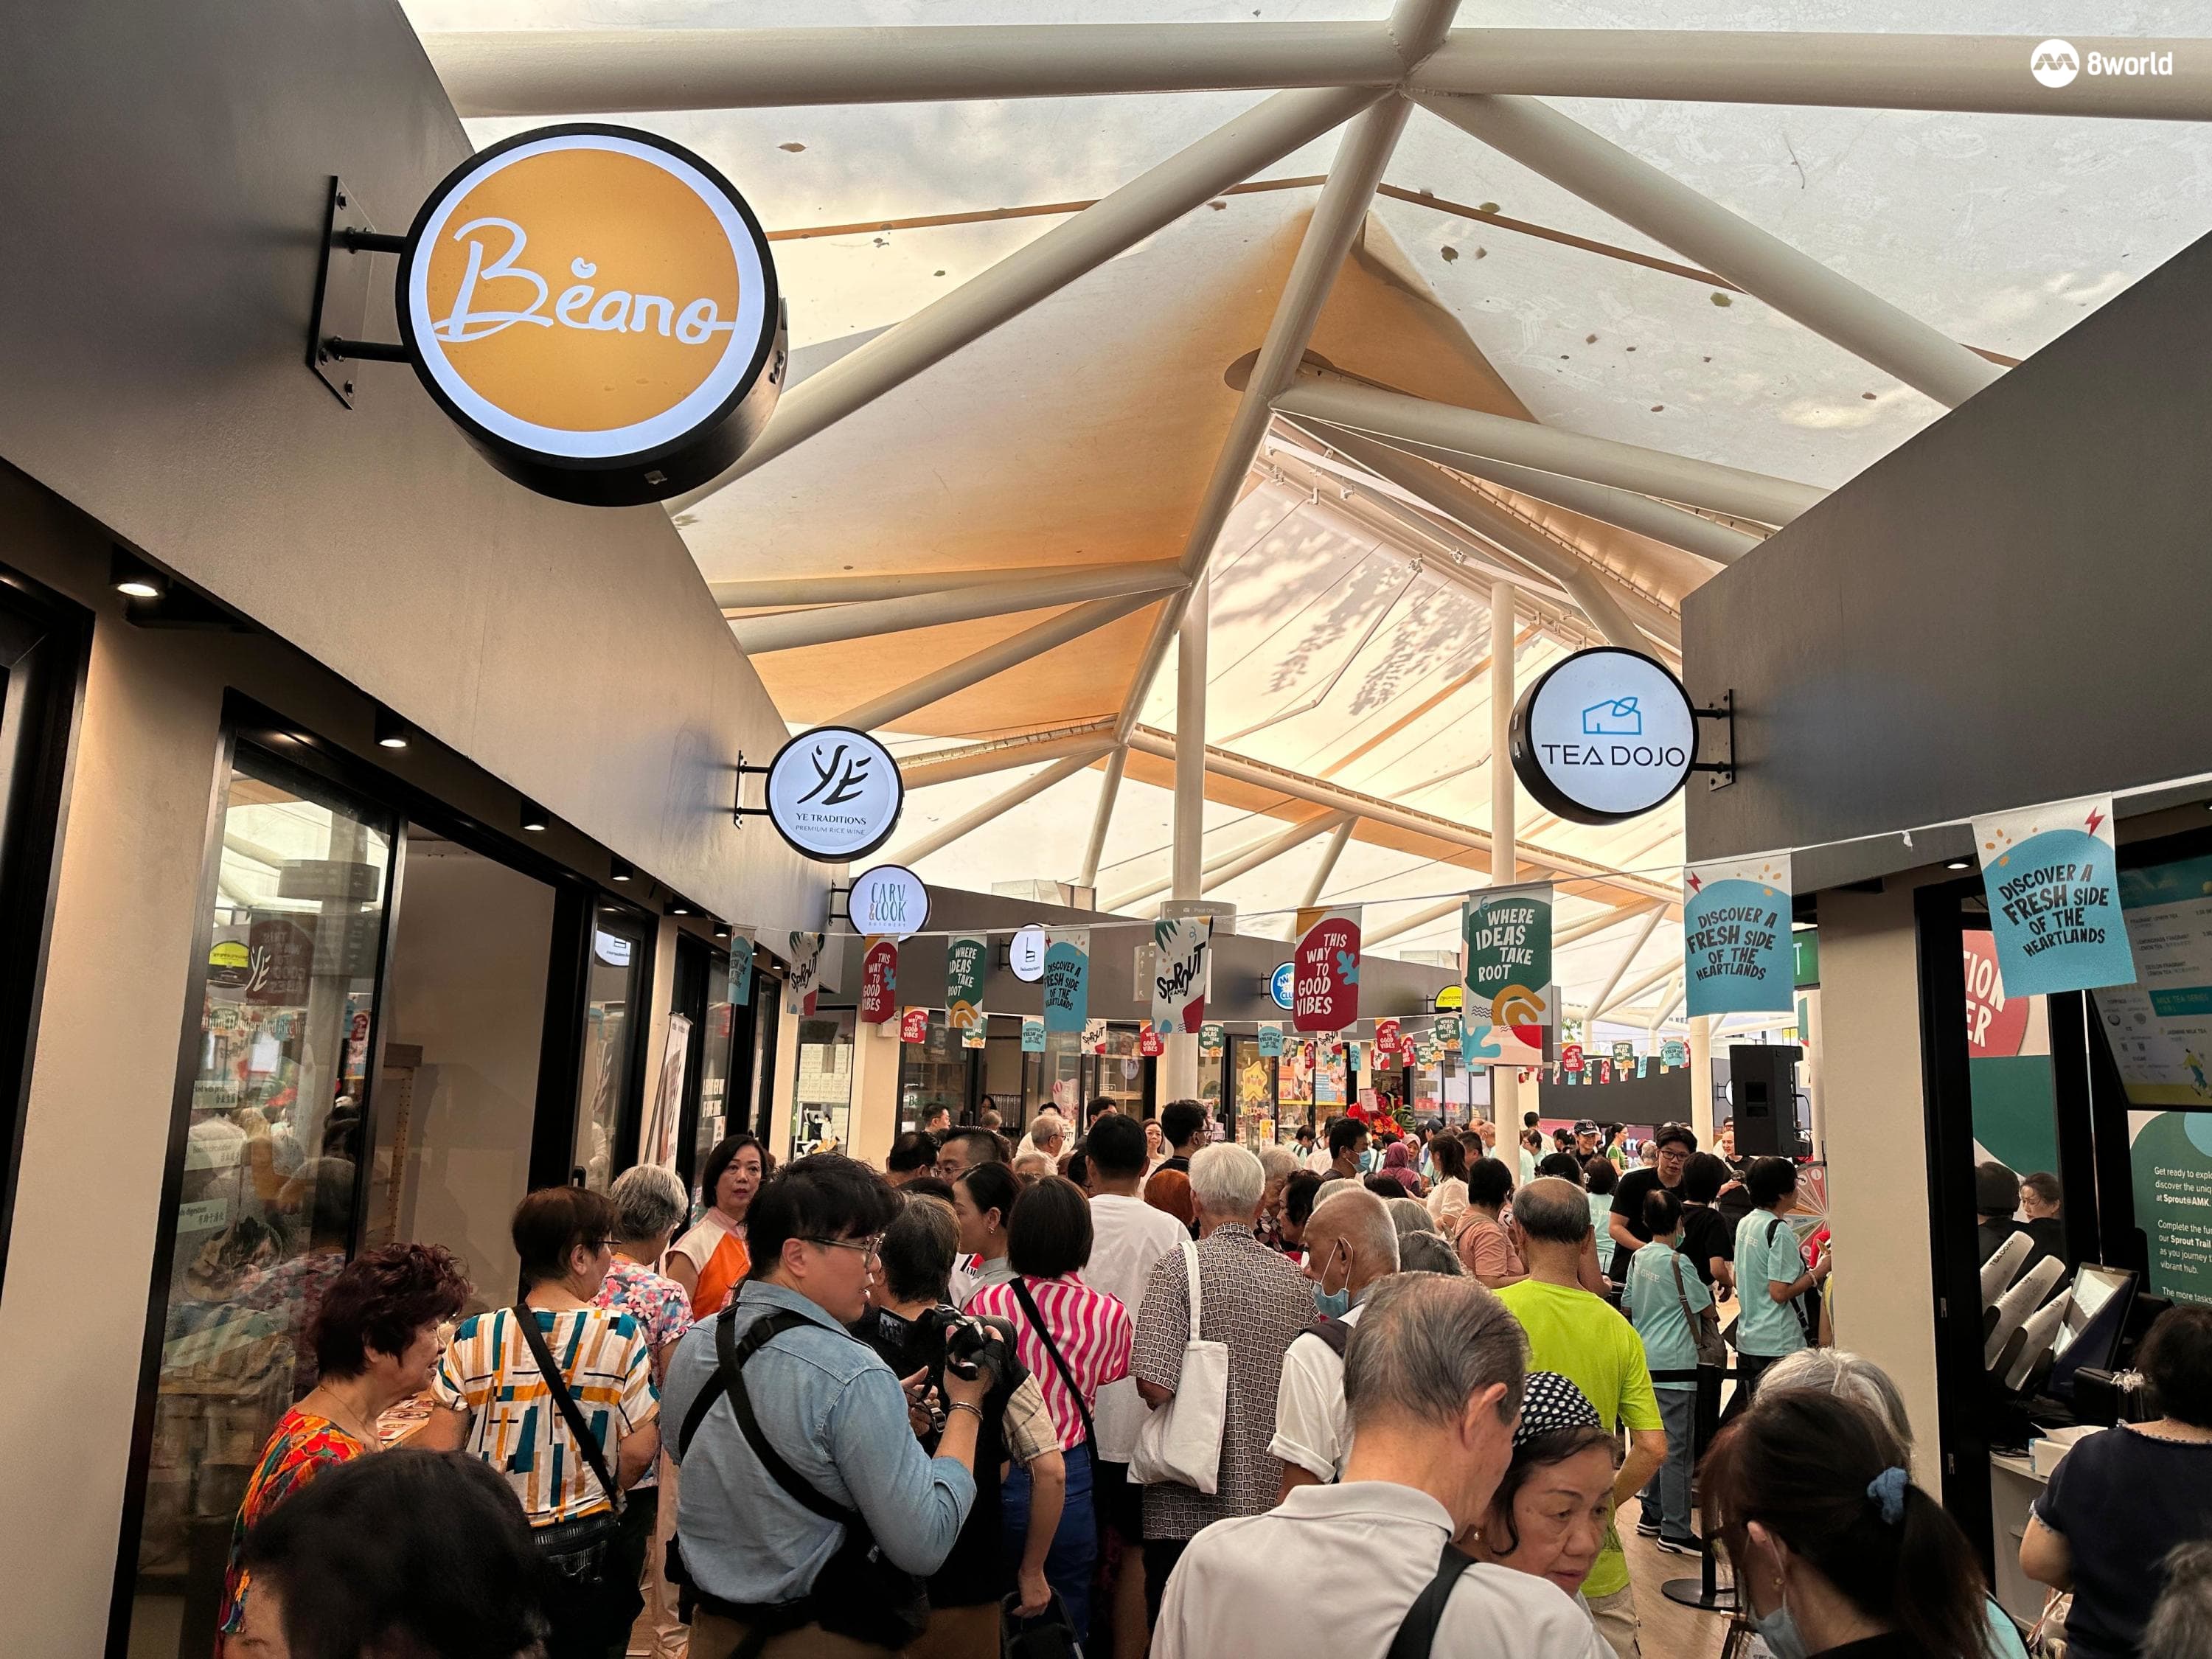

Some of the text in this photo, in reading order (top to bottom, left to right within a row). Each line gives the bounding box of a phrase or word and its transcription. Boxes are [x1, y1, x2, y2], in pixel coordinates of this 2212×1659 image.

[1542, 745, 1685, 767] TEA DOJO
[811, 814, 866, 825] TRADITIONS
[1998, 864, 2093, 901] DISCOVER A
[872, 883, 905, 903] CARV
[2002, 885, 2109, 926] FRESH SIDE
[1487, 908, 1535, 926] WHERE
[1697, 907, 1778, 929] DISCOVER A
[2029, 907, 2084, 936] OF THE
[1324, 933, 1348, 947] THIS
[1475, 925, 1526, 950] IDEAS
[1686, 925, 1776, 955] FRESH SIDE
[2023, 928, 2106, 957] HEARTLANDS
[878, 953, 891, 964] THIS
[955, 947, 978, 959] WHERE
[1307, 947, 1331, 964] WAY
[1499, 947, 1534, 966] TAKE
[1708, 947, 1759, 965] OF THE
[791, 951, 818, 992] SPROUT
[869, 963, 883, 973] WAY
[950, 959, 972, 974] IDEAS
[1048, 961, 1074, 973] DISCOVER
[1074, 966, 1082, 977] A
[1156, 942, 1206, 1004] SPROUT
[1316, 963, 1329, 976] TO
[1478, 964, 1512, 982] ROOT
[1696, 963, 1766, 981] HEARTLANDS
[873, 973, 880, 984] TO
[957, 973, 975, 987] TAKE
[1044, 973, 1079, 992] FRESH SIDE
[1298, 977, 1331, 996] GOOD
[863, 984, 880, 997] GOOD
[1050, 989, 1071, 1000] OF THE
[862, 998, 880, 1012] VIBES
[1046, 998, 1074, 1011] HEARTLANDS
[1296, 997, 1332, 1017] VIBES
[1082, 1026, 1105, 1045] SPROUT
[2154, 1166, 2166, 1175] Get
[2167, 1169, 2185, 1179] ready
[2155, 1180, 2182, 1189] discover
[2184, 1183, 2194, 1191] the
[2158, 1220, 2188, 1231] Complete
[2191, 1225, 2202, 1233] the
[2171, 1235, 2194, 1245] Sprout
[2195, 1239, 2211, 1248] Trail
[2168, 1250, 2180, 1258] you
[2182, 1251, 2207, 1263] journey
[2160, 1262, 2198, 1274] vibrant hub.
[2162, 1287, 2174, 1296] The
[2176, 1291, 2193, 1300] more
